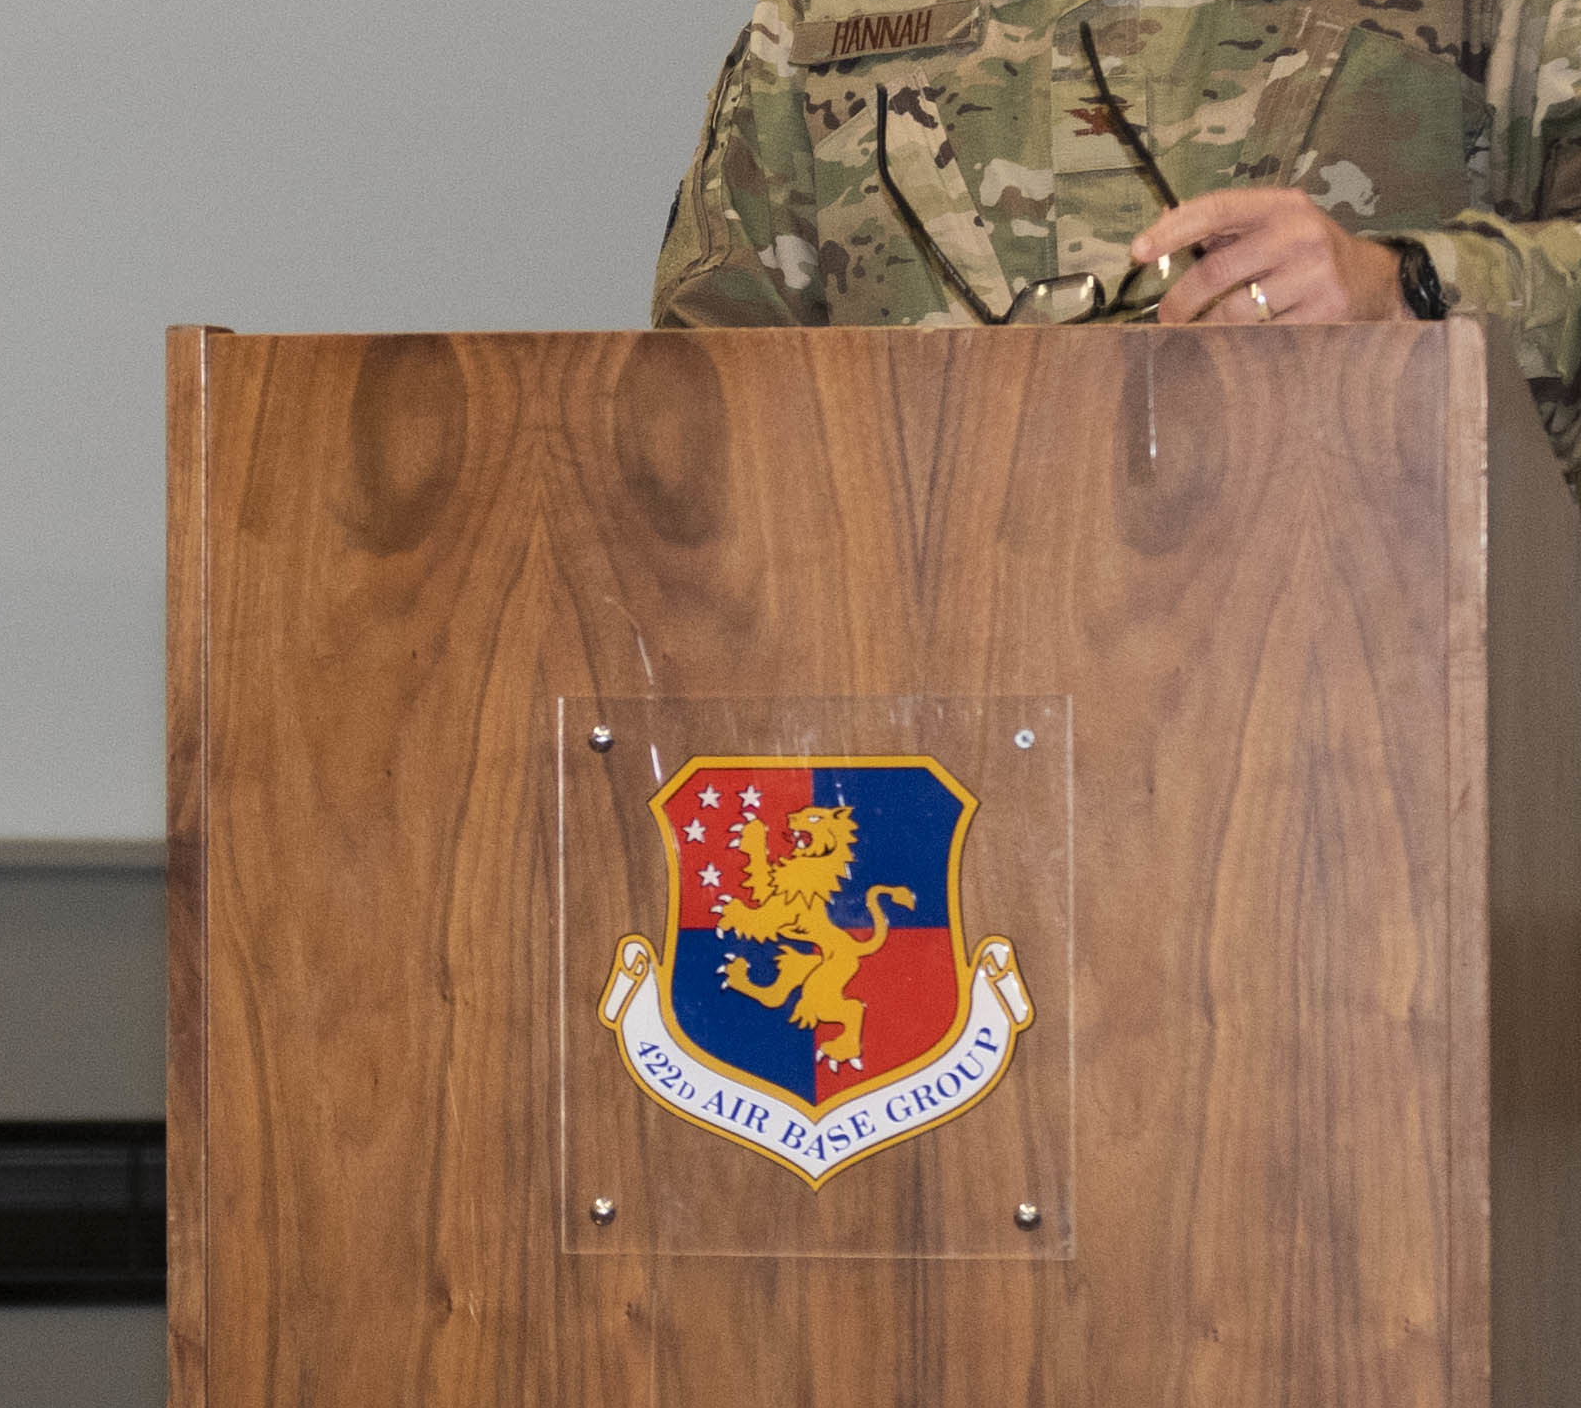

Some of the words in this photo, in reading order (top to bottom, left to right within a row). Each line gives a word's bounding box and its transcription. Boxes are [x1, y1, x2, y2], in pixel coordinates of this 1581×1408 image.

[830, 9, 933, 56] HANNAH
[700, 1089, 770, 1134] AIR
[778, 1109, 877, 1162] BASE
[885, 1026, 999, 1123] GROUP
